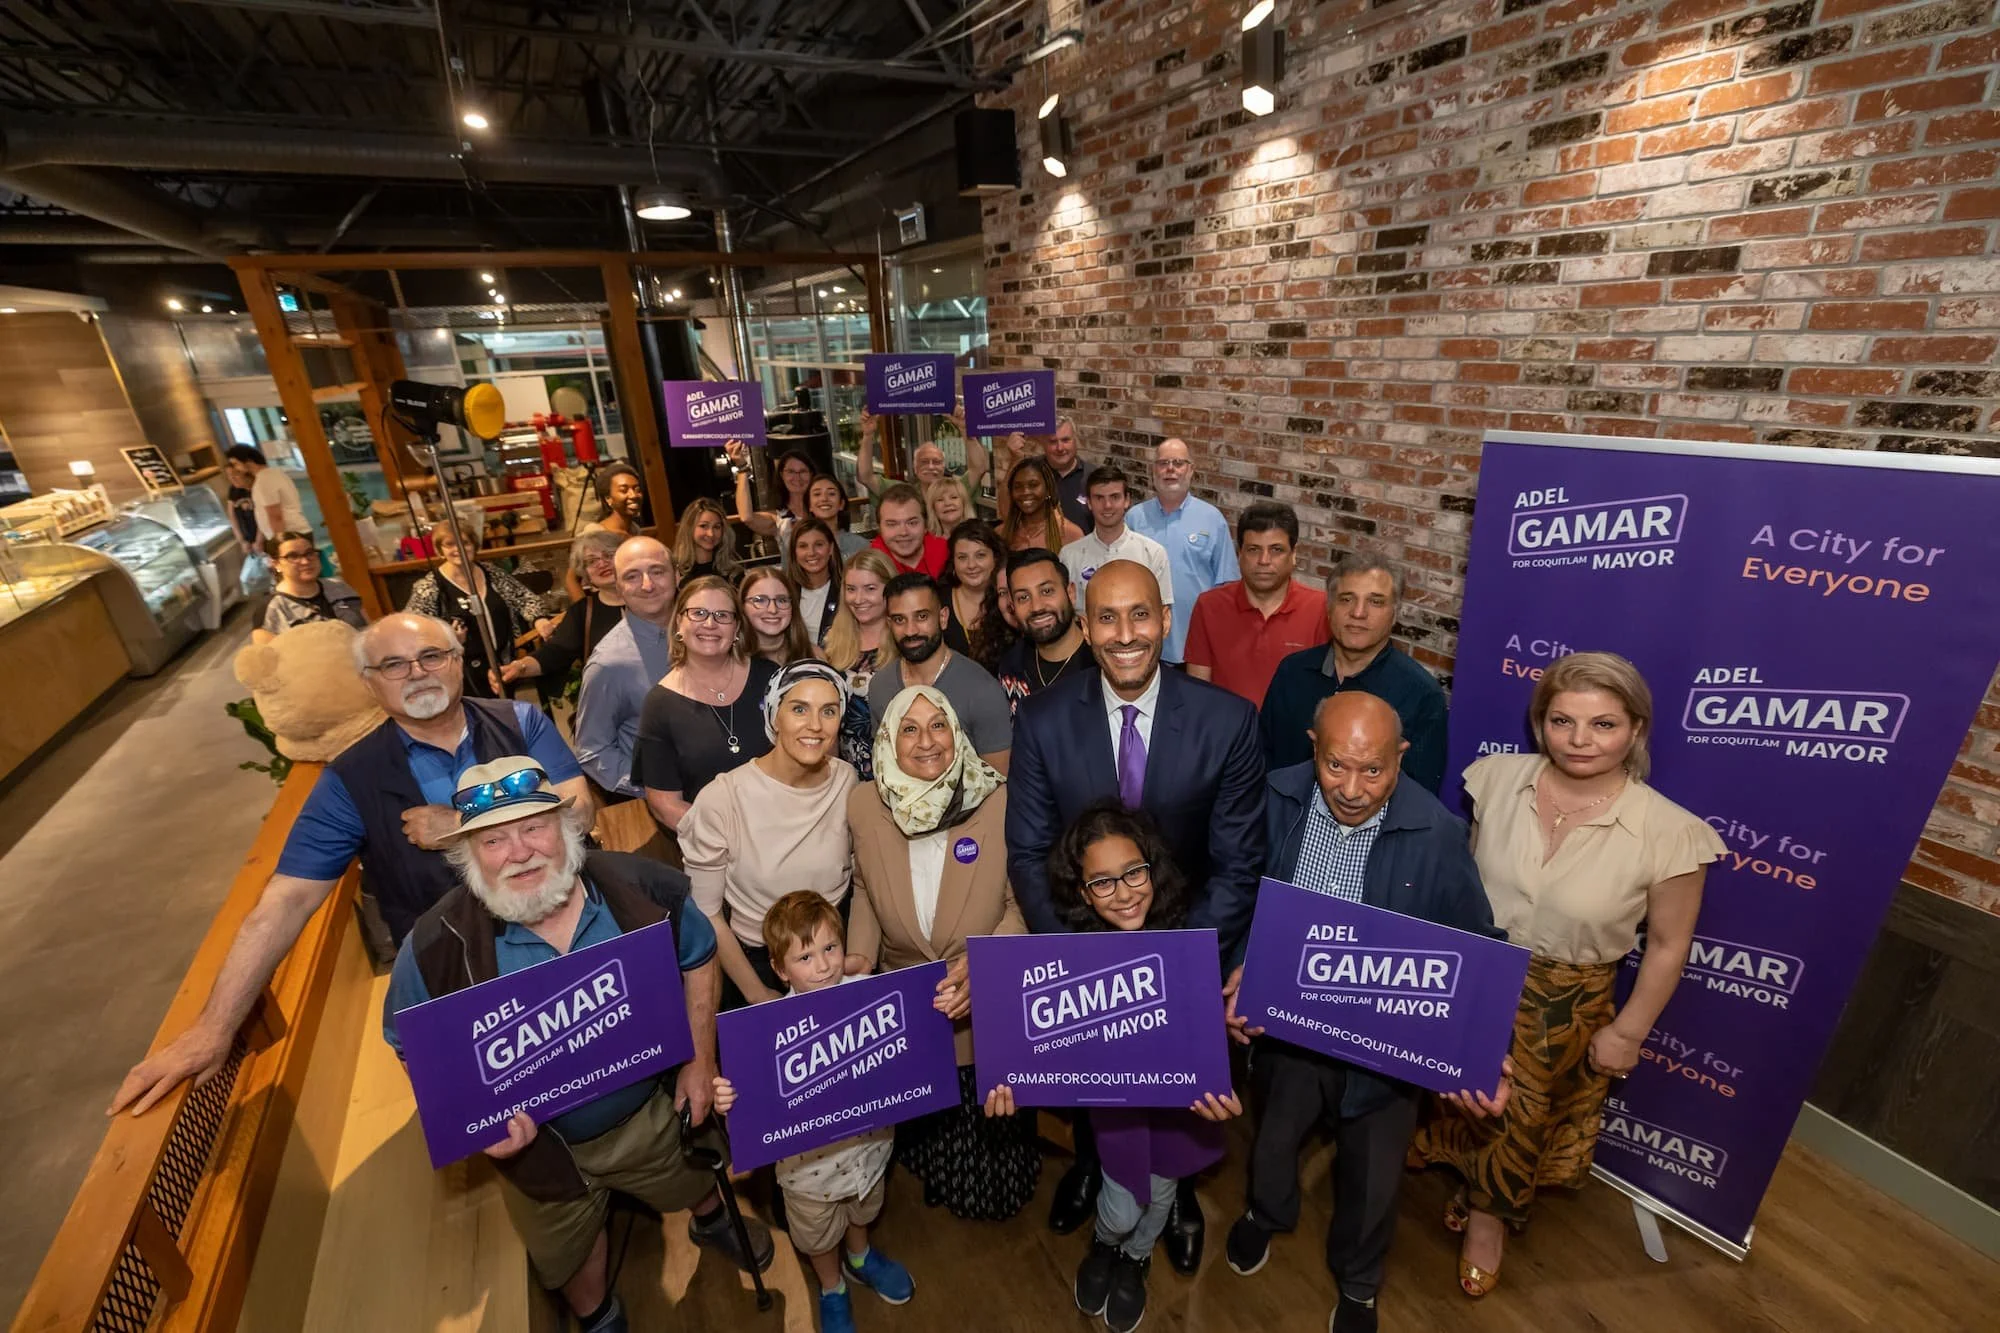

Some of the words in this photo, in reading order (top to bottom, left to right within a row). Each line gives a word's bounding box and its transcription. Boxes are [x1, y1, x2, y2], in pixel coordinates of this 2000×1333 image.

[885, 363, 902, 373] ADEL
[888, 365, 934, 388] GAMAR
[686, 391, 706, 402] ADEL
[913, 380, 936, 392] MAYOR
[982, 381, 1000, 393] ADEL
[986, 384, 1032, 409] GAMAR
[690, 394, 740, 418] GAMAR
[719, 410, 744, 423] MAYOR
[1012, 399, 1036, 413] MAYOR
[1514, 487, 1569, 509] ADEL
[1518, 506, 1672, 548] GAMAR
[1512, 560, 1530, 568] FOR
[1532, 556, 1587, 568] COQUITLAM
[1592, 549, 1675, 570] MAYOR
[1750, 525, 1775, 547] A
[1789, 529, 1872, 564] City
[1882, 537, 1945, 566] for
[1742, 557, 1930, 602] Everyone
[1506, 634, 1522, 652] A
[1694, 667, 1763, 684] ADEL
[1696, 696, 1889, 734] GAMAR
[1687, 735, 1709, 744] FOR
[1712, 736, 1780, 748] COQUITLAM
[1785, 740, 1888, 764] MAYOR
[1778, 836, 1827, 864] for
[1306, 924, 1359, 942] ADEL
[1022, 959, 1069, 988] ADEL
[1307, 953, 1449, 990] GAMAR
[1031, 966, 1158, 1029] GAMAR
[1300, 992, 1319, 1002] FOR
[1320, 993, 1371, 1005] COQUITLAM
[1376, 998, 1450, 1018] MAYOR
[1707, 977, 1789, 1010] MAYOR
[472, 998, 525, 1039] ADEL
[486, 972, 620, 1070] GAMAR
[775, 1015, 820, 1049] ADEL
[1034, 1042, 1050, 1055] FOR
[1051, 1029, 1098, 1050] COQUITLAM
[1103, 1008, 1168, 1042] MAYOR
[493, 1078, 513, 1096] FOR
[513, 1045, 564, 1081] COQUITLAM
[568, 1003, 632, 1054] MAYOR
[784, 1003, 899, 1084] GAMAR
[1267, 1006, 1462, 1078] GAMARFORCOQUITLAM.COM
[787, 1095, 804, 1110] FOR
[804, 1070, 848, 1099] COQUITLAM
[851, 1037, 908, 1079] MAYOR
[1640, 1048, 1736, 1098] eryone
[1703, 1051, 1743, 1078] for
[466, 1044, 663, 1135] GAMARFORCOQUITLAM.COM
[1007, 1073, 1196, 1086] GAMARFORCOQUITLAM.COM
[762, 1085, 932, 1144] GAMARFORCOQUITLAM.COM
[1648, 1154, 1716, 1189] MAYOR
